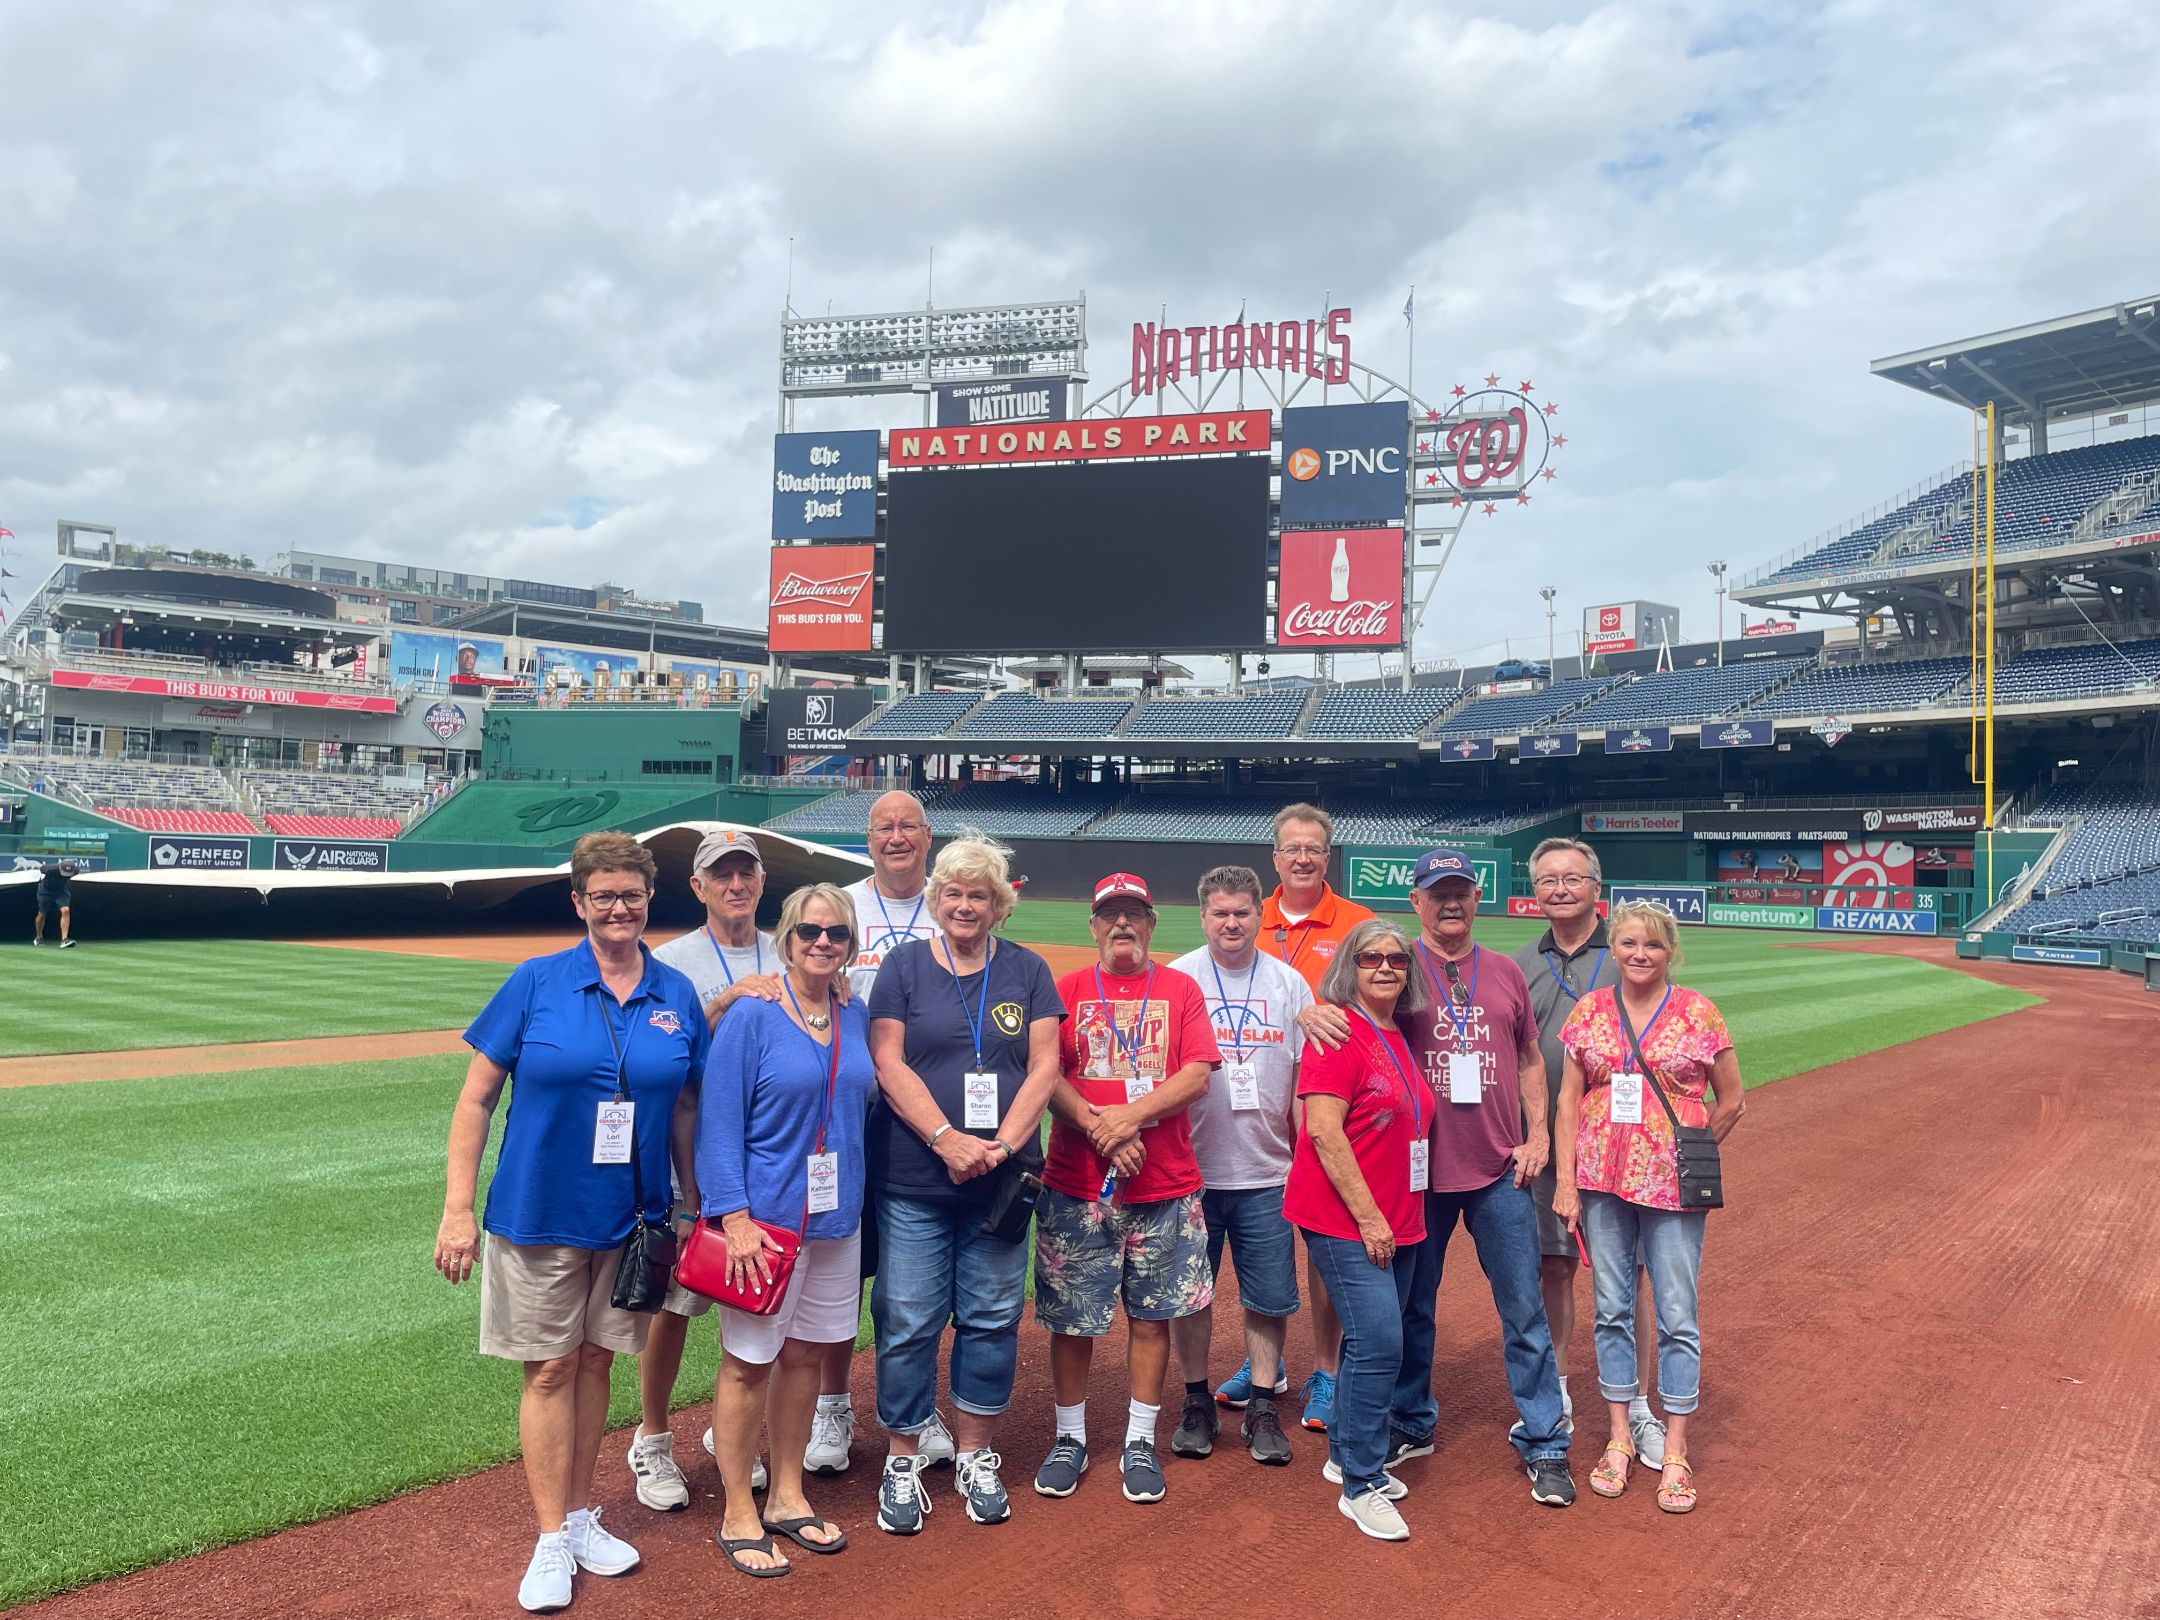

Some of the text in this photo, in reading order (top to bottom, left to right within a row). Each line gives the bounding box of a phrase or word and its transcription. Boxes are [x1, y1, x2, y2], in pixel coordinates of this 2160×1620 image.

[1131, 307, 1352, 397] NATIONALS
[952, 384, 1012, 398] SHOW SOME
[968, 390, 1050, 422] NATITUDE
[901, 419, 1248, 458] NATIONALS PARK
[809, 446, 841, 466] The
[1326, 446, 1399, 476] PNC
[777, 471, 873, 495] Washington
[804, 499, 843, 523] Post
[779, 579, 860, 598] Budweiser
[777, 614, 864, 624] THIS BUD'S FOR YOU.
[1283, 600, 1396, 637] Coca-Cola
[1595, 632, 1626, 641] TOYOTA
[398, 666, 421, 677] JOSIAH
[166, 681, 299, 704] THIS BUD'S FOR YOU.
[426, 715, 466, 726] CHAMPIONS
[787, 728, 850, 741] BETMGM
[1718, 732, 1753, 741] CHAMPIONS
[1606, 817, 1680, 829] Harris Teeter
[1886, 810, 1954, 824] WASHINGTON
[1917, 816, 1977, 829] NATIONALS
[1693, 831, 1848, 841] NATIONALS PHILANTHROPIES #NATS4GOOD
[181, 847, 243, 860] PENFED
[318, 850, 346, 864] AIR
[346, 857, 379, 865] GUARD
[1917, 894, 1933, 909] 335
[1712, 909, 1796, 925] amentum
[1832, 910, 1916, 932] RE/MAX
[1437, 1006, 1485, 1022] KEEP
[1116, 1019, 1163, 1053] MVP
[1242, 1029, 1285, 1043] SLAM
[1432, 1023, 1490, 1042] CALM
[1425, 1050, 1496, 1068] TOCH
